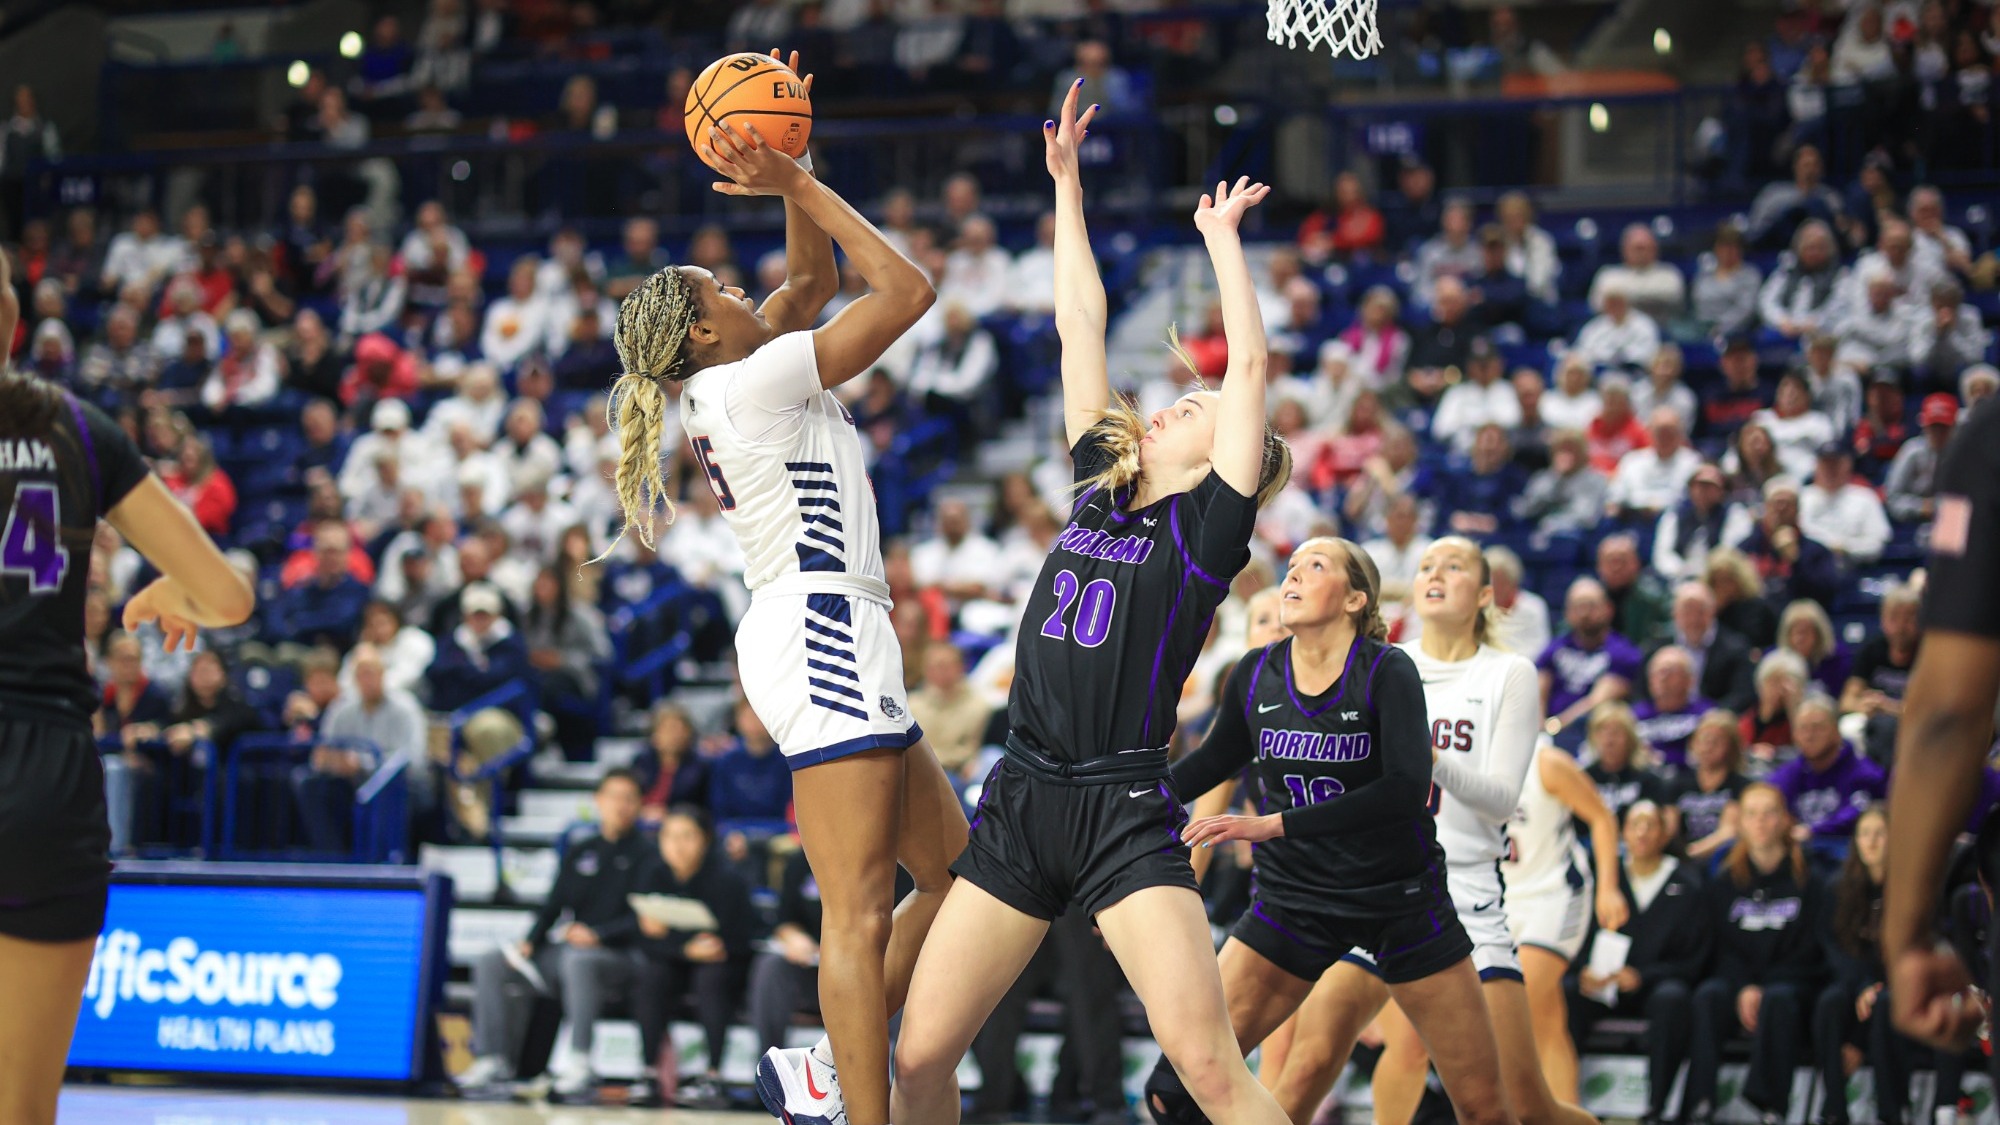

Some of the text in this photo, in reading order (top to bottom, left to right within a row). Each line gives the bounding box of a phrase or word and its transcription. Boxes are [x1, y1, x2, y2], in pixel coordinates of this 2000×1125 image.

[1050, 521, 1155, 565] PORTLAND
[1040, 569, 1117, 648] 20
[1260, 727, 1372, 762] PORTLAND
[157, 1014, 335, 1056] HEALTH PLANS
